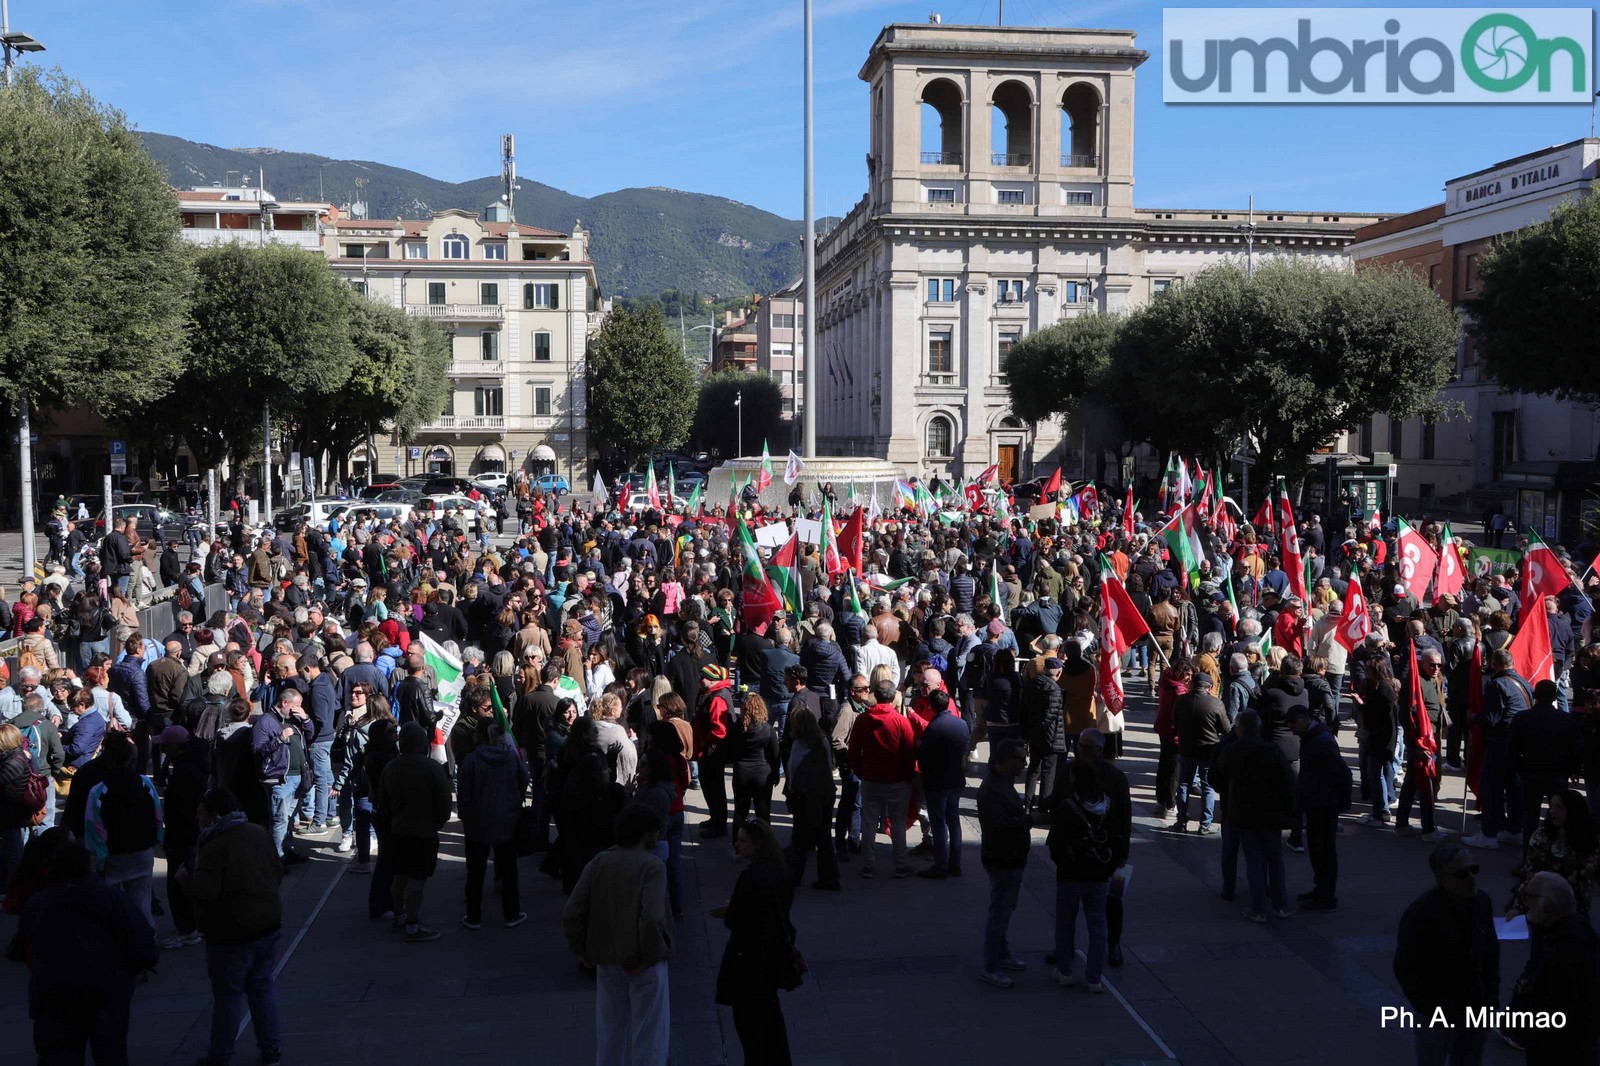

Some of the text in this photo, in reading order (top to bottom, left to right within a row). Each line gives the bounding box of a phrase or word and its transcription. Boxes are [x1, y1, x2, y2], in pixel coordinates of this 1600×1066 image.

[1465, 164, 1560, 203] BANCA D'ITALIA
[113, 442, 122, 453] P
